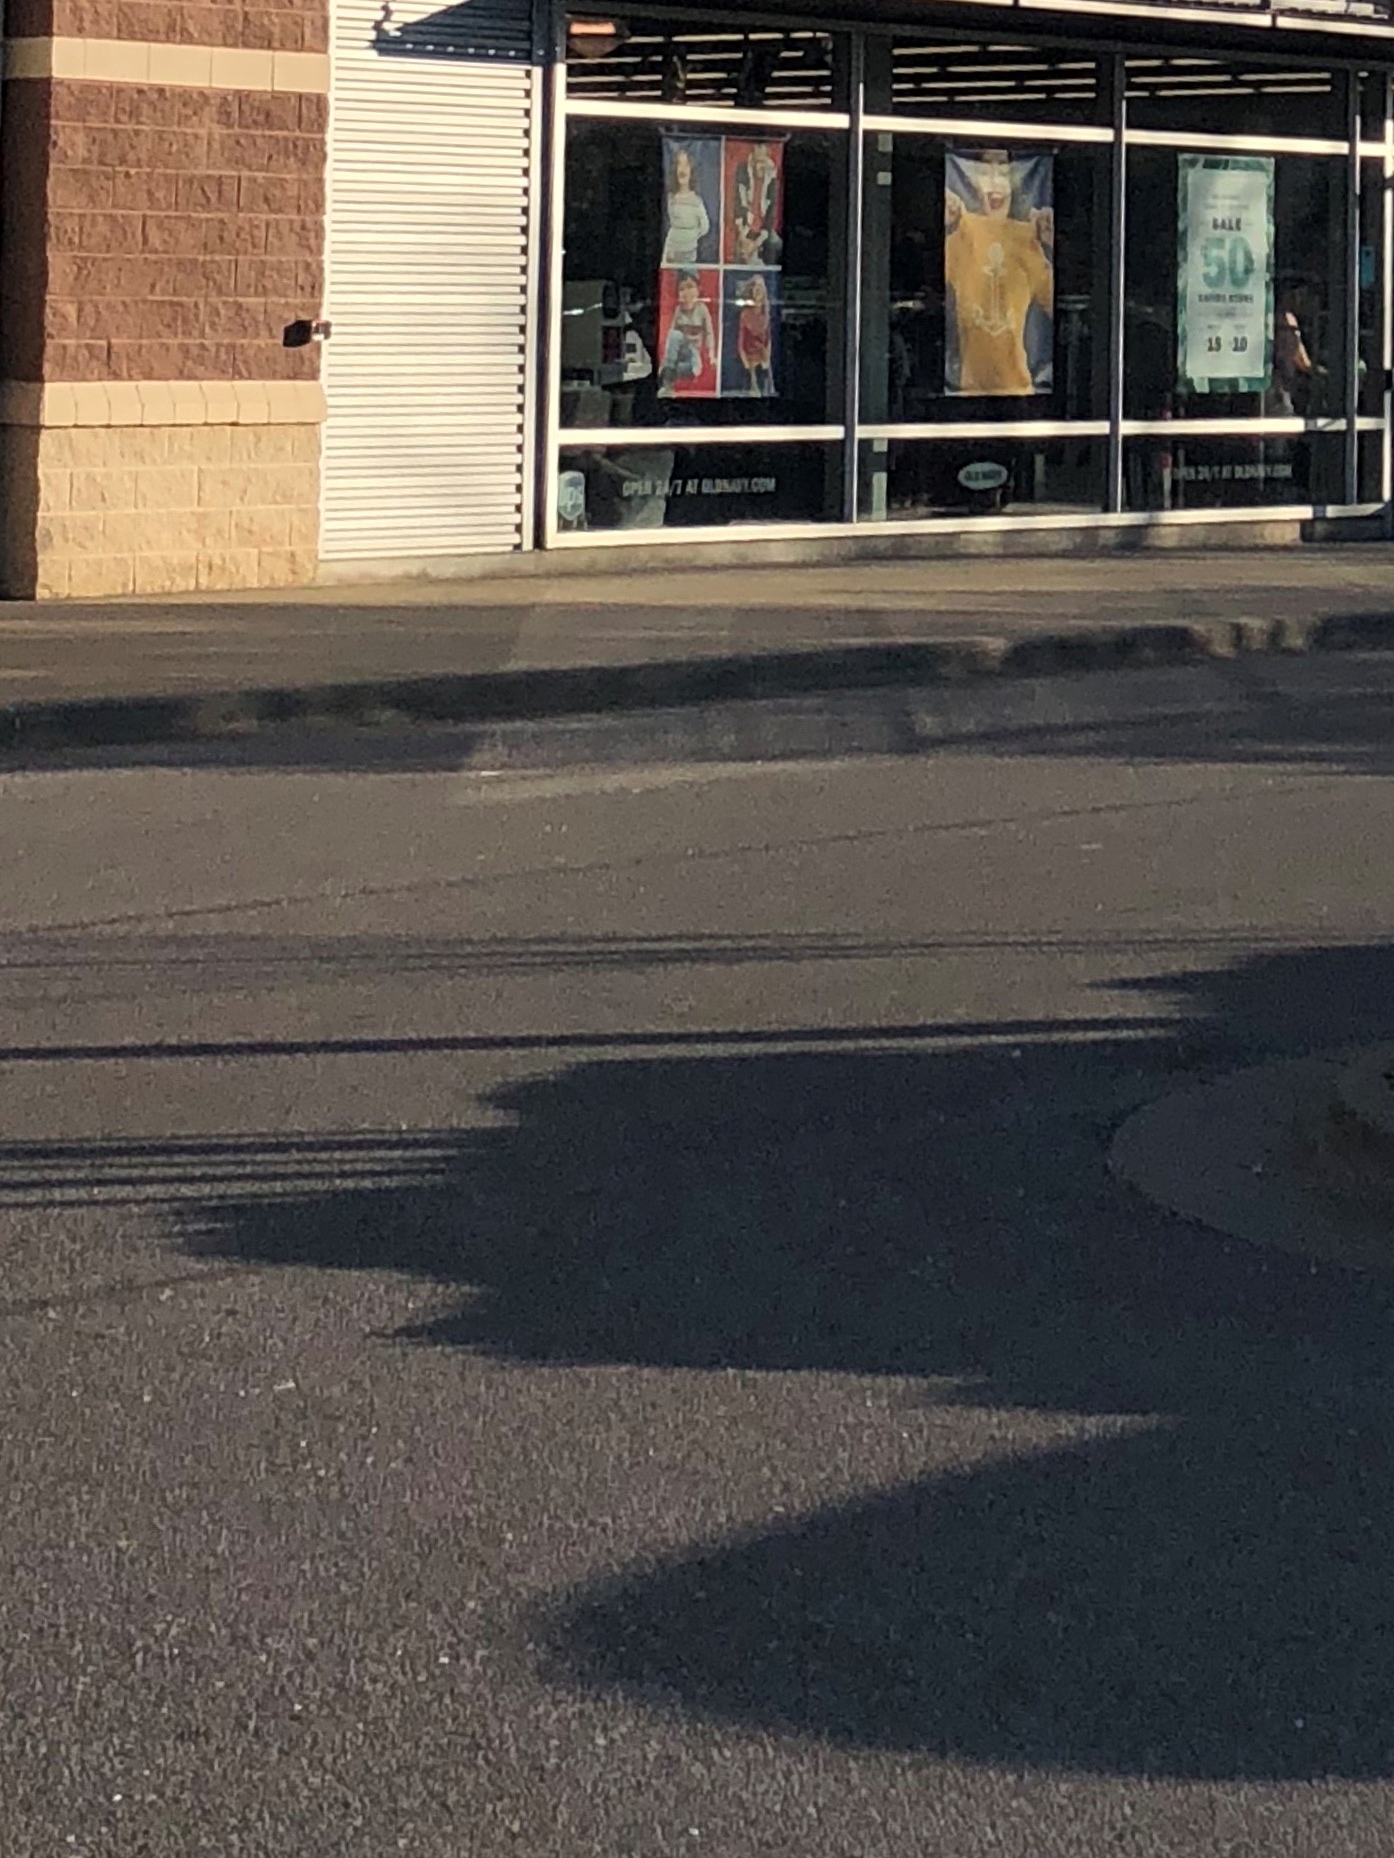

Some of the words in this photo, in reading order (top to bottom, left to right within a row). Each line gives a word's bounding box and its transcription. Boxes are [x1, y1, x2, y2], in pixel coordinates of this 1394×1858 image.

[1212, 217, 1241, 231] SALE
[1201, 236, 1254, 290] 50
[622, 479, 652, 497] OPEN
